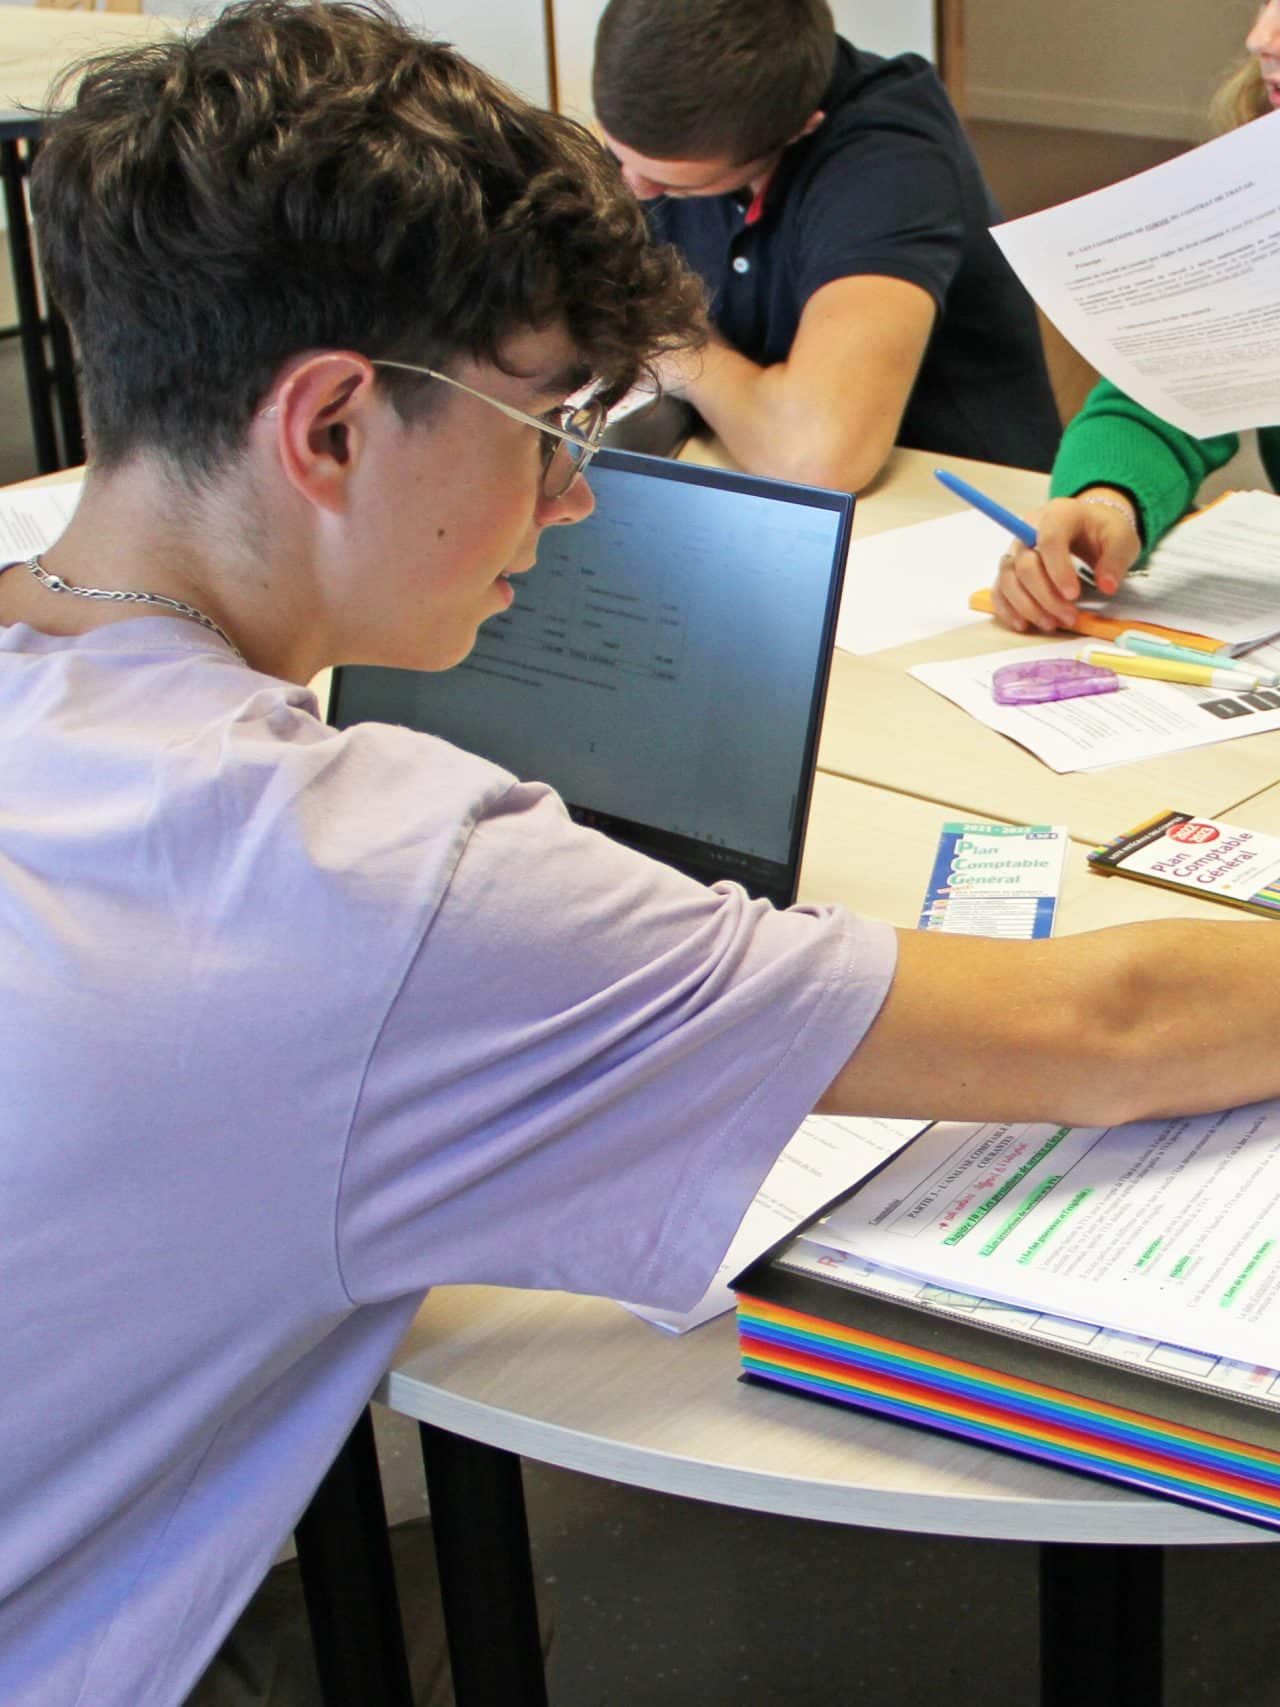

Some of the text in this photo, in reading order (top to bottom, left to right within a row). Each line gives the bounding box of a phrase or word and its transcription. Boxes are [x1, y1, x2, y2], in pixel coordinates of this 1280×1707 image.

[958, 840, 998, 855] Plan
[1172, 832, 1254, 878] Comptable
[953, 858, 1049, 871] Comptable
[1151, 852, 1191, 873] Plan
[1196, 850, 1258, 884] Général
[949, 872, 1021, 885] Général
